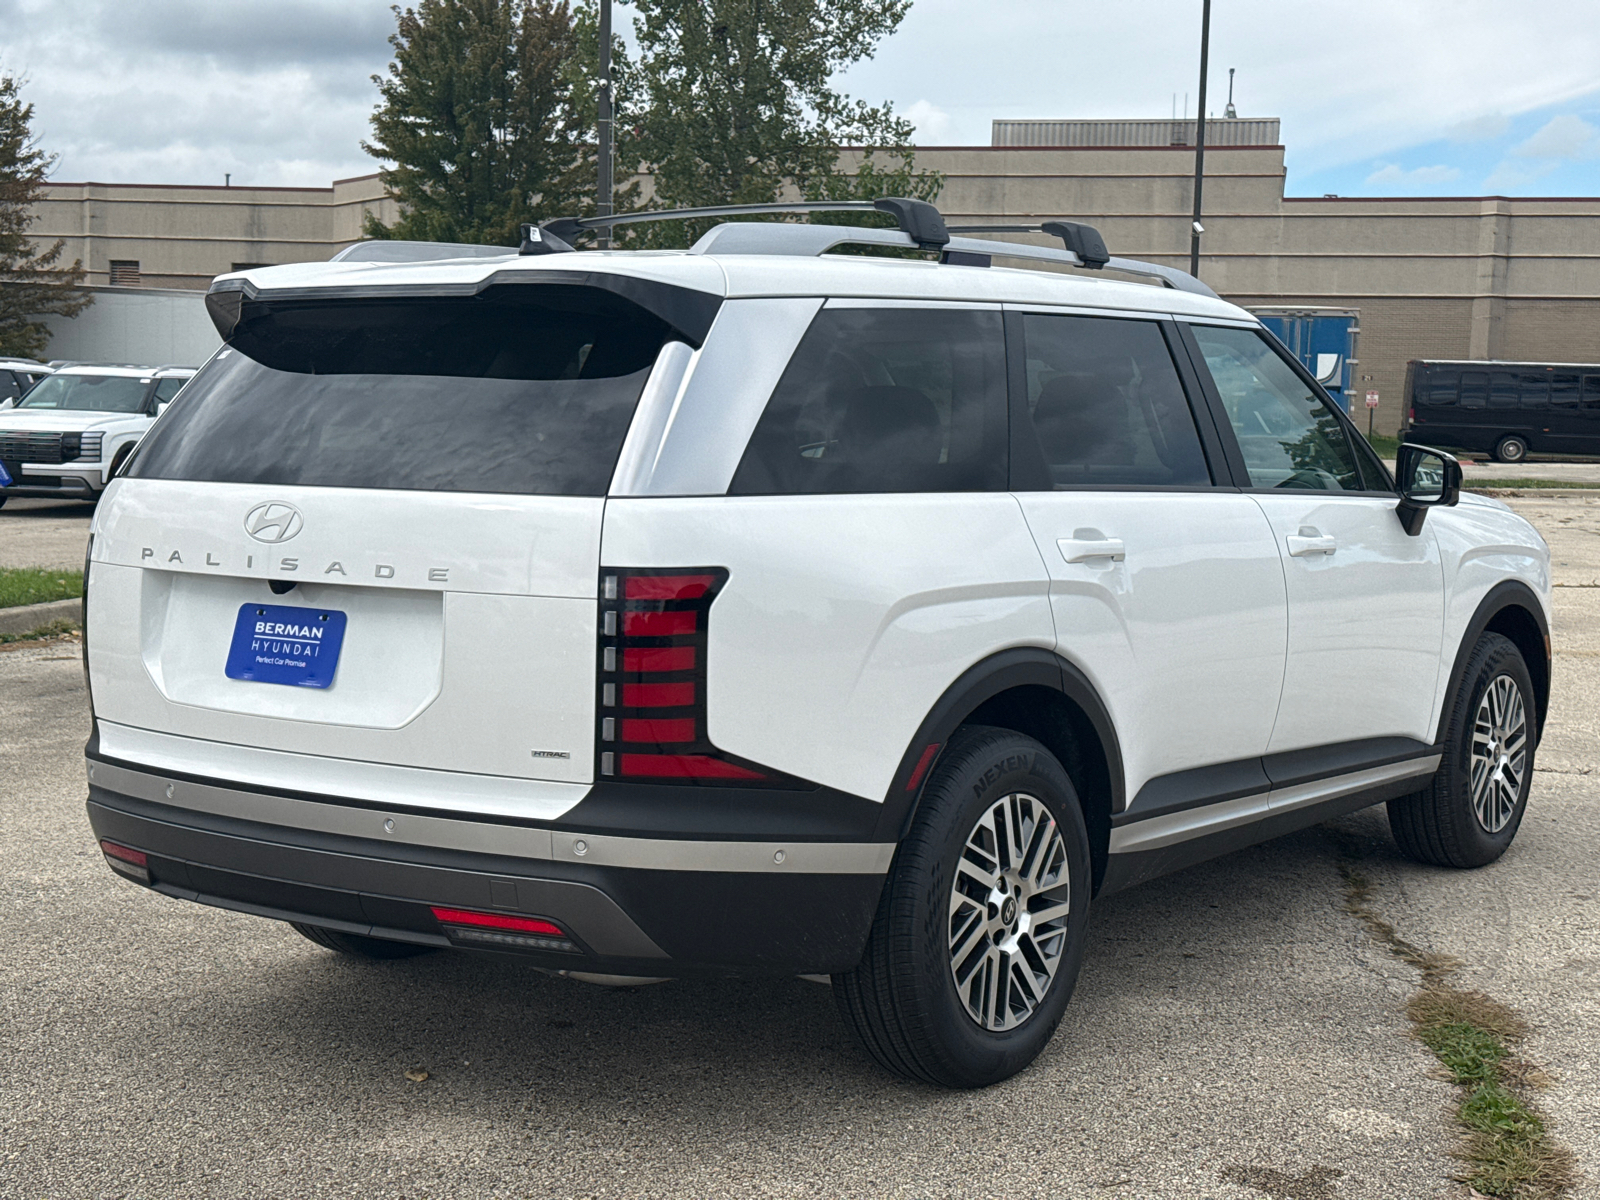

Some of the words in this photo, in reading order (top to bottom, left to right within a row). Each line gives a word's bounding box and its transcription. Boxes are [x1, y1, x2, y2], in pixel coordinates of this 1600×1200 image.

[141, 547, 450, 582] PALISADE
[255, 622, 323, 638] BERMAN
[251, 640, 319, 657] HYUNDAI
[255, 656, 274, 664] Perfect
[274, 657, 284, 665] Car
[284, 658, 306, 667] Promise
[533, 750, 567, 758] HTRAC
[972, 754, 1029, 799] NEXEN
